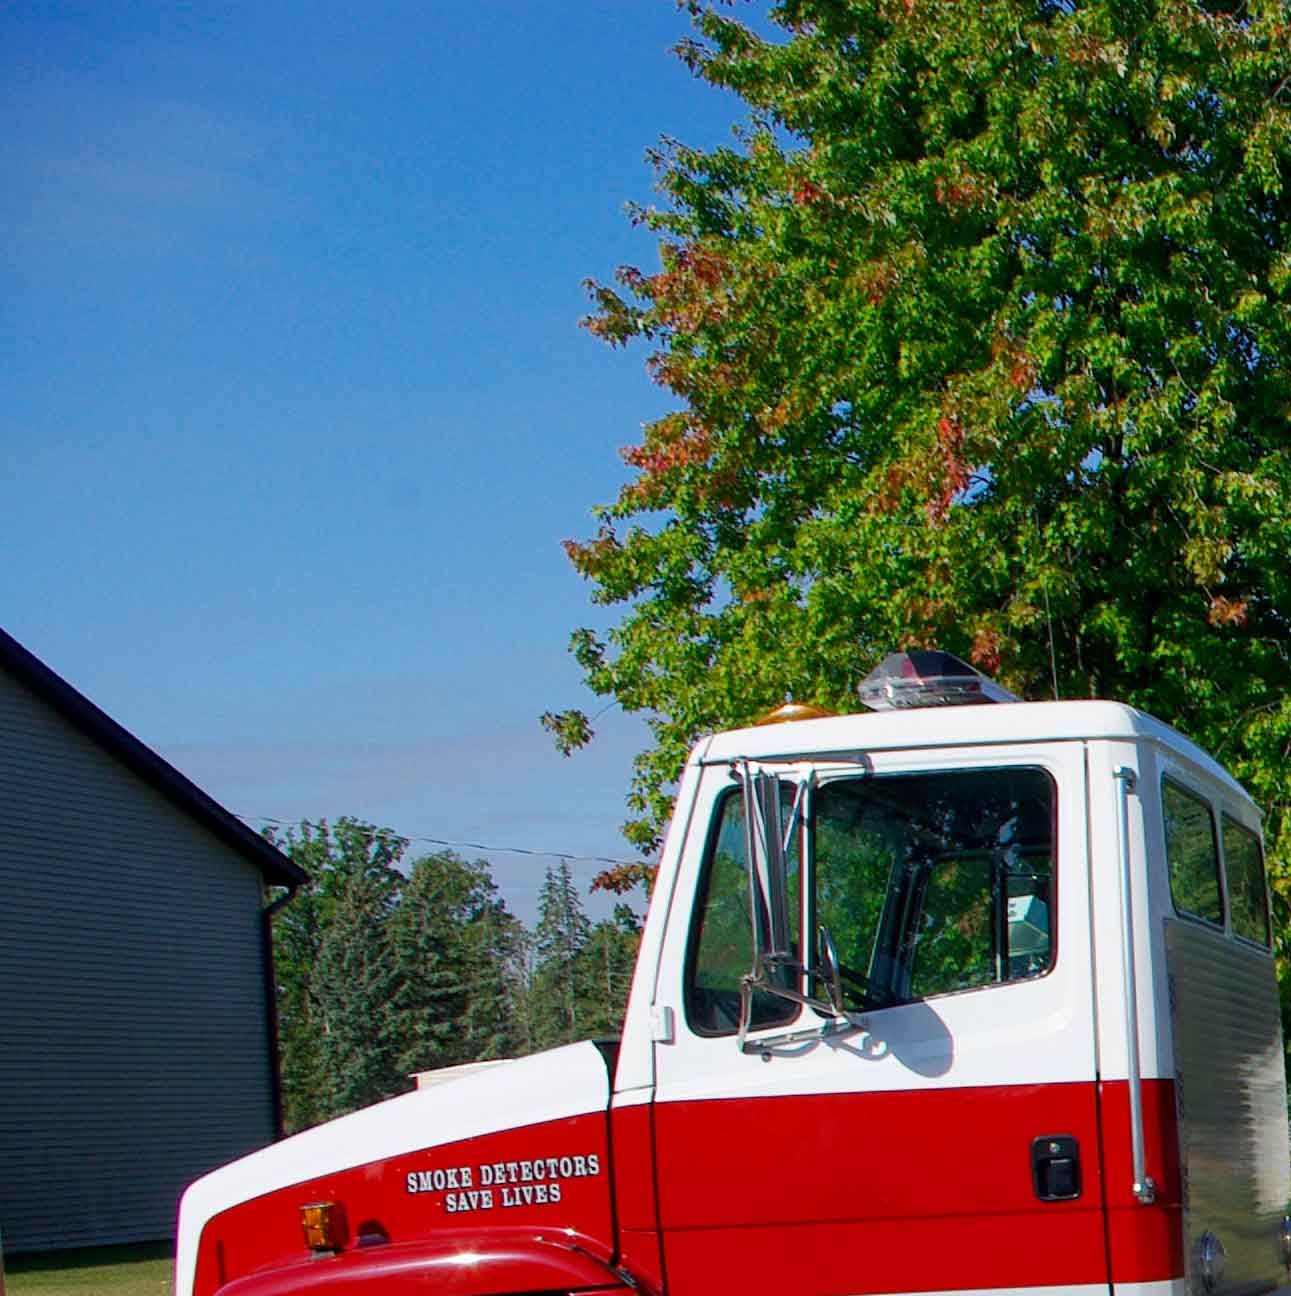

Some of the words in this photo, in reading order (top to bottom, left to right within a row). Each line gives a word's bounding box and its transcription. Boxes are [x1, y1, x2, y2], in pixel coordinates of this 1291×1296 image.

[407, 1167, 473, 1193] SMOKE
[480, 1154, 600, 1186] DETECTORS
[446, 1189, 493, 1213] SAVE
[502, 1183, 561, 1207] LIVES
